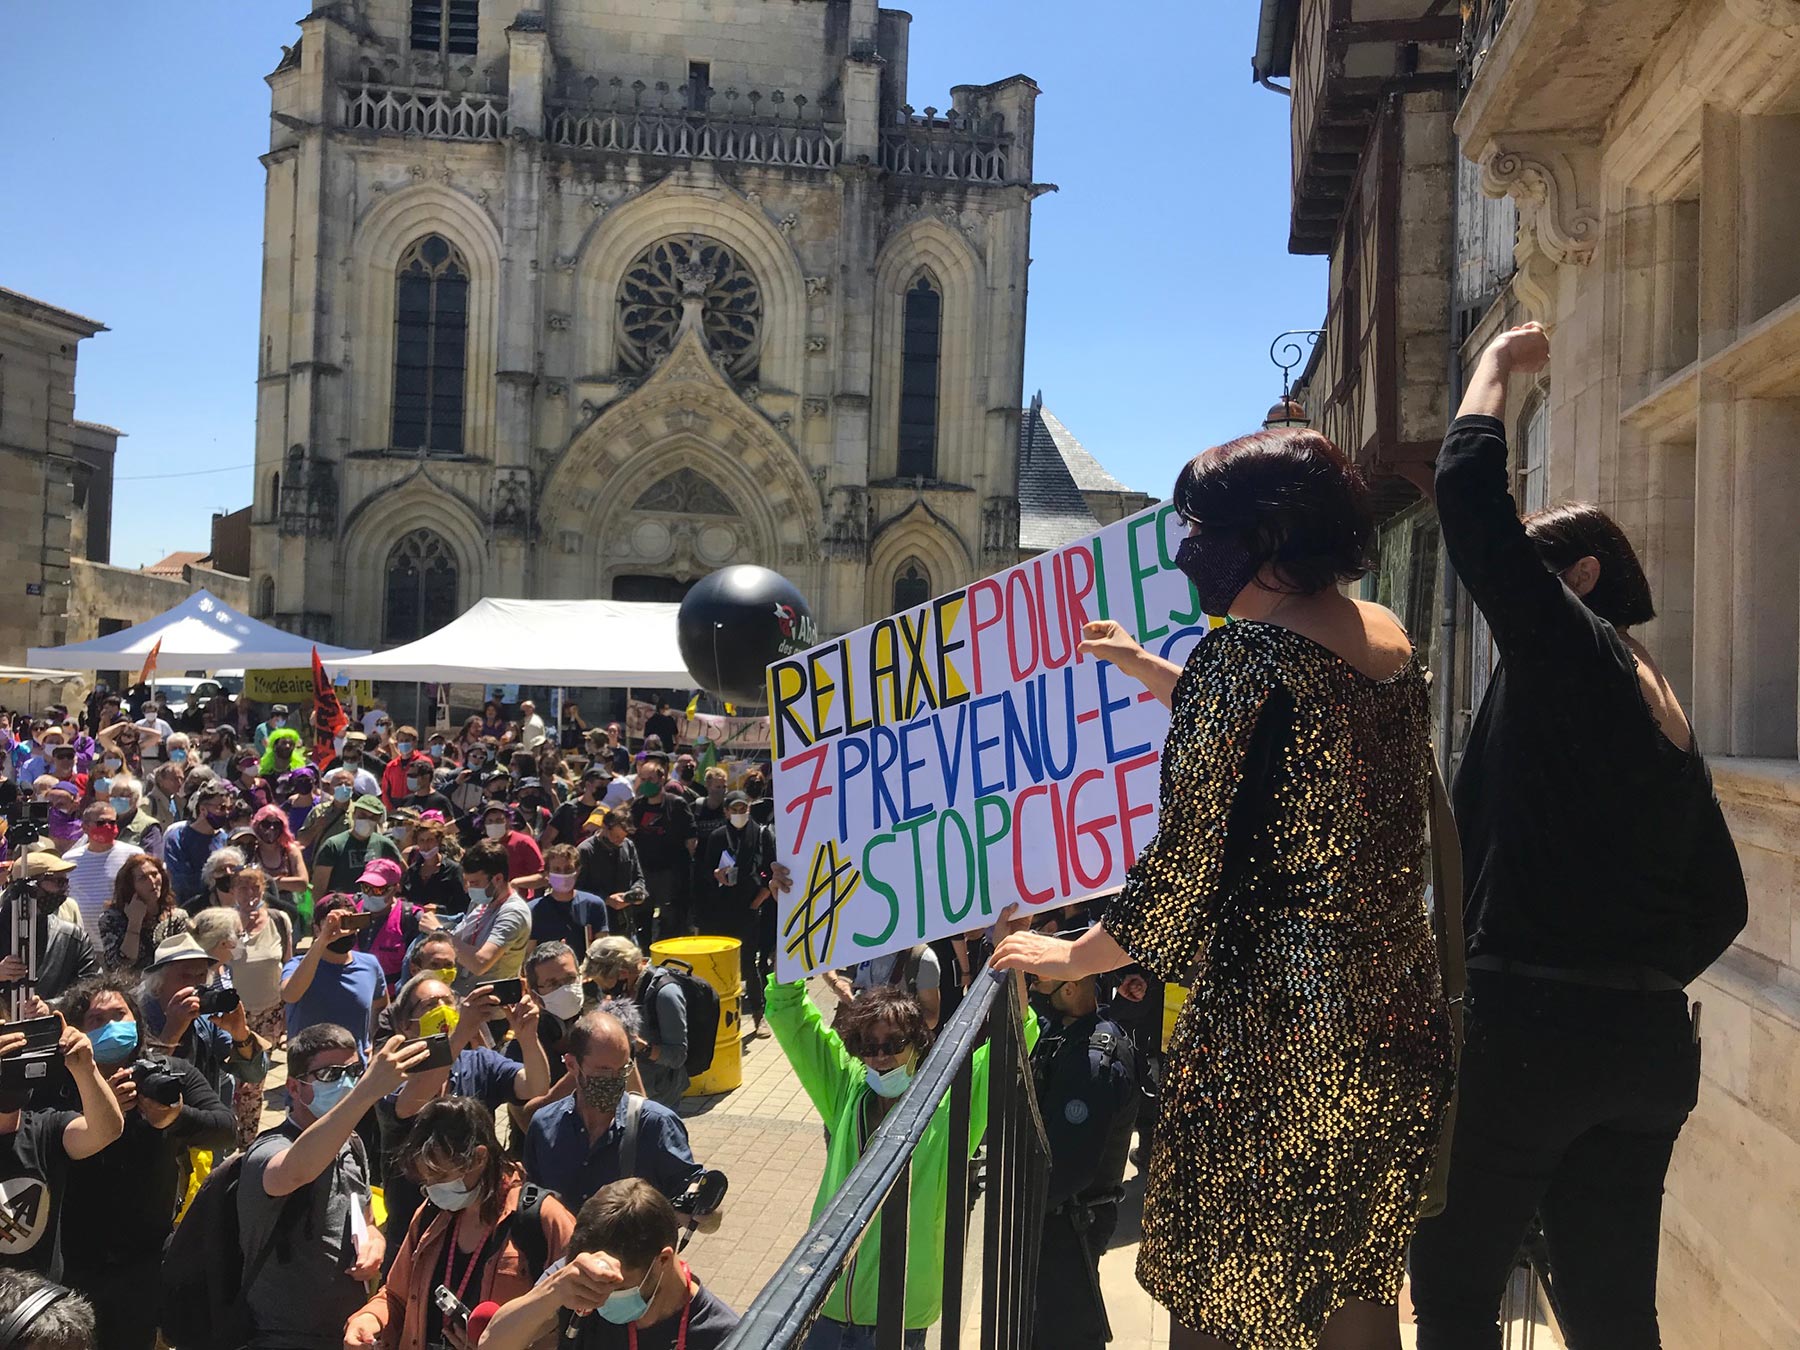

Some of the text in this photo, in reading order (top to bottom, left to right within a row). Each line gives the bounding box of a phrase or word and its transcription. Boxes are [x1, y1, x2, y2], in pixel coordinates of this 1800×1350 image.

[253, 676, 313, 694] Nucléaire
[772, 504, 1202, 759] RELAXE POUR LES
[781, 626, 1204, 855] 7 PRÉVENU-E-
